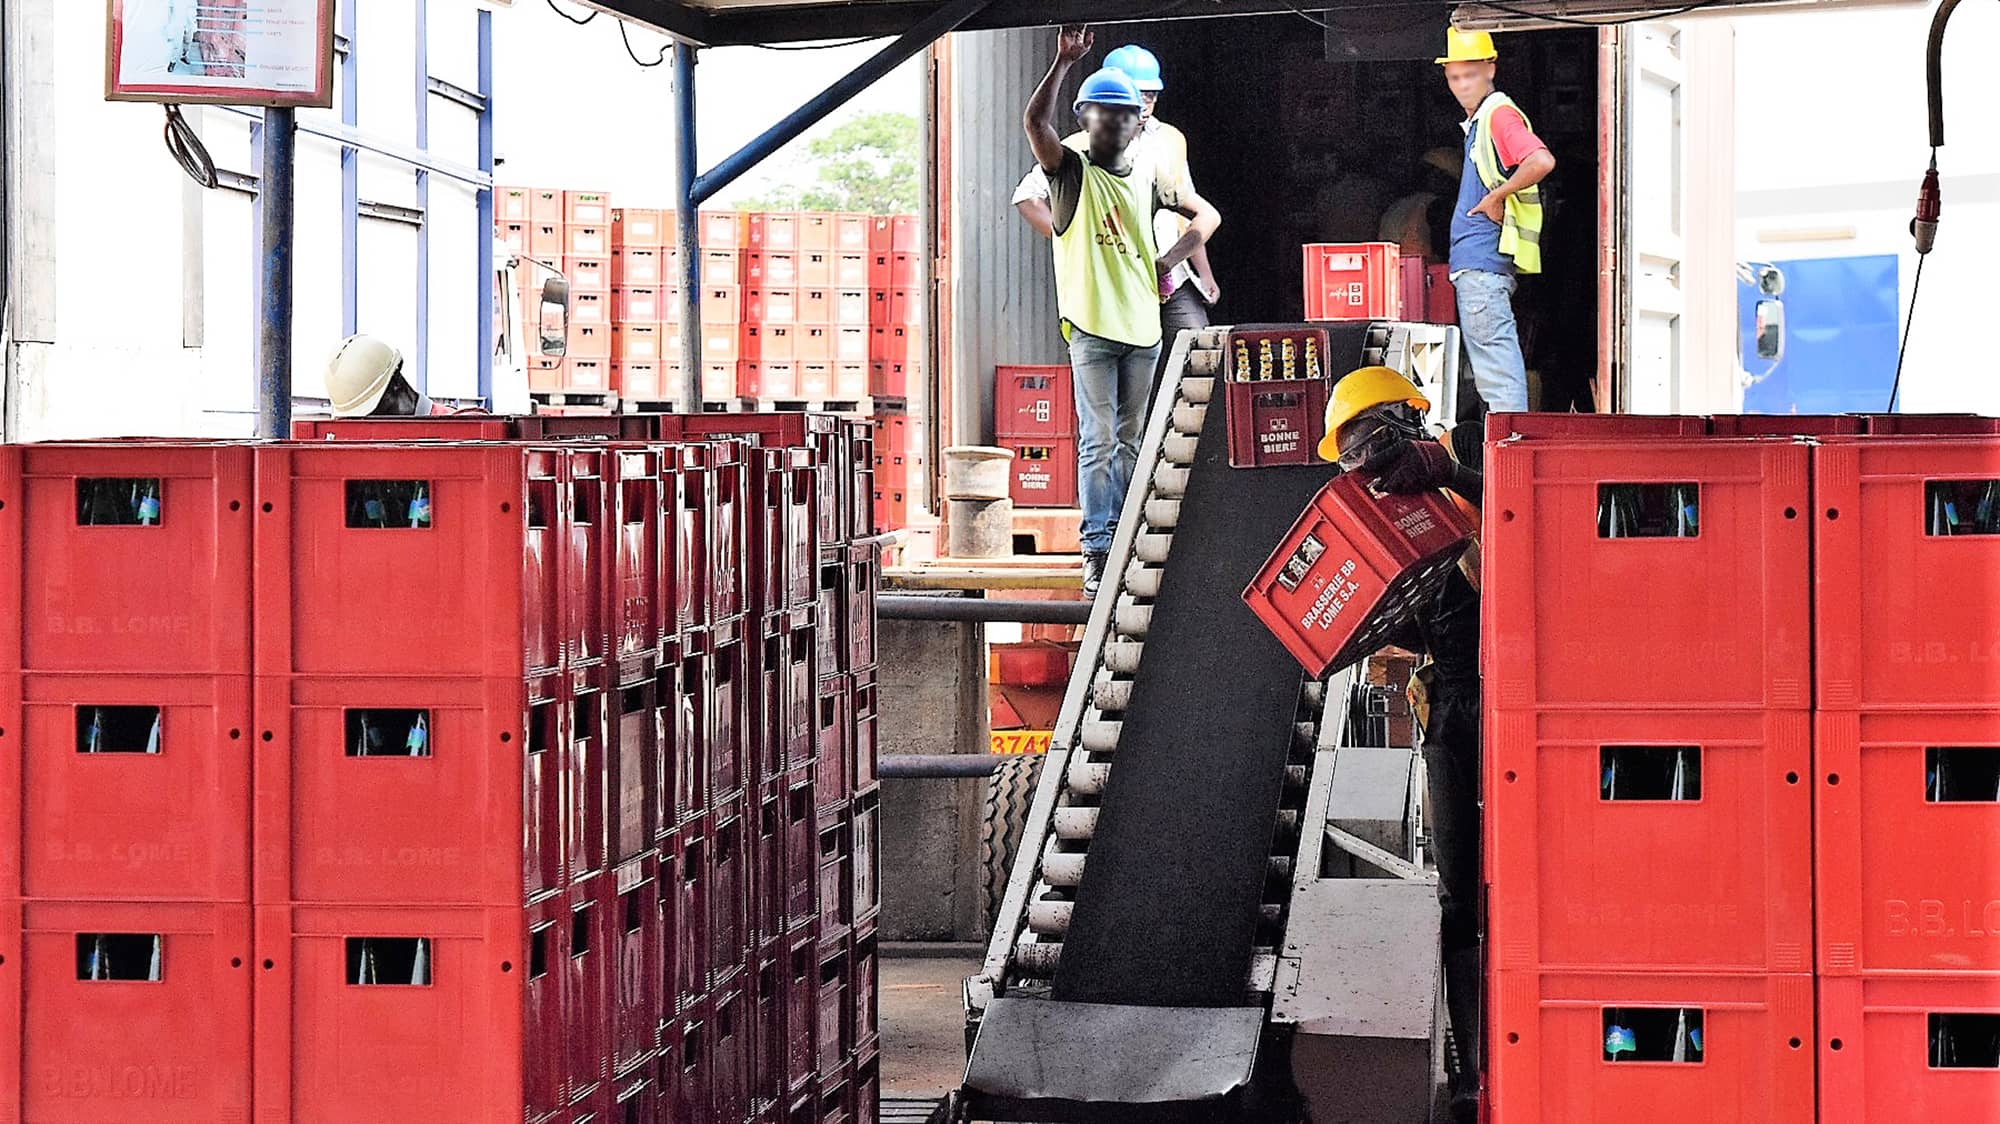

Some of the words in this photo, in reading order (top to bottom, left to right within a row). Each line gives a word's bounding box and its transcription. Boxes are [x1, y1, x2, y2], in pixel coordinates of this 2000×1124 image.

[1260, 431, 1300, 443] BONNE
[1263, 442, 1297, 454] BIERE
[1393, 507, 1431, 530] BONNE
[1301, 573, 1345, 630] BRASSERIE
[1340, 559, 1356, 577] BB
[1317, 597, 1344, 630] LOME
[111, 615, 191, 634] LOME
